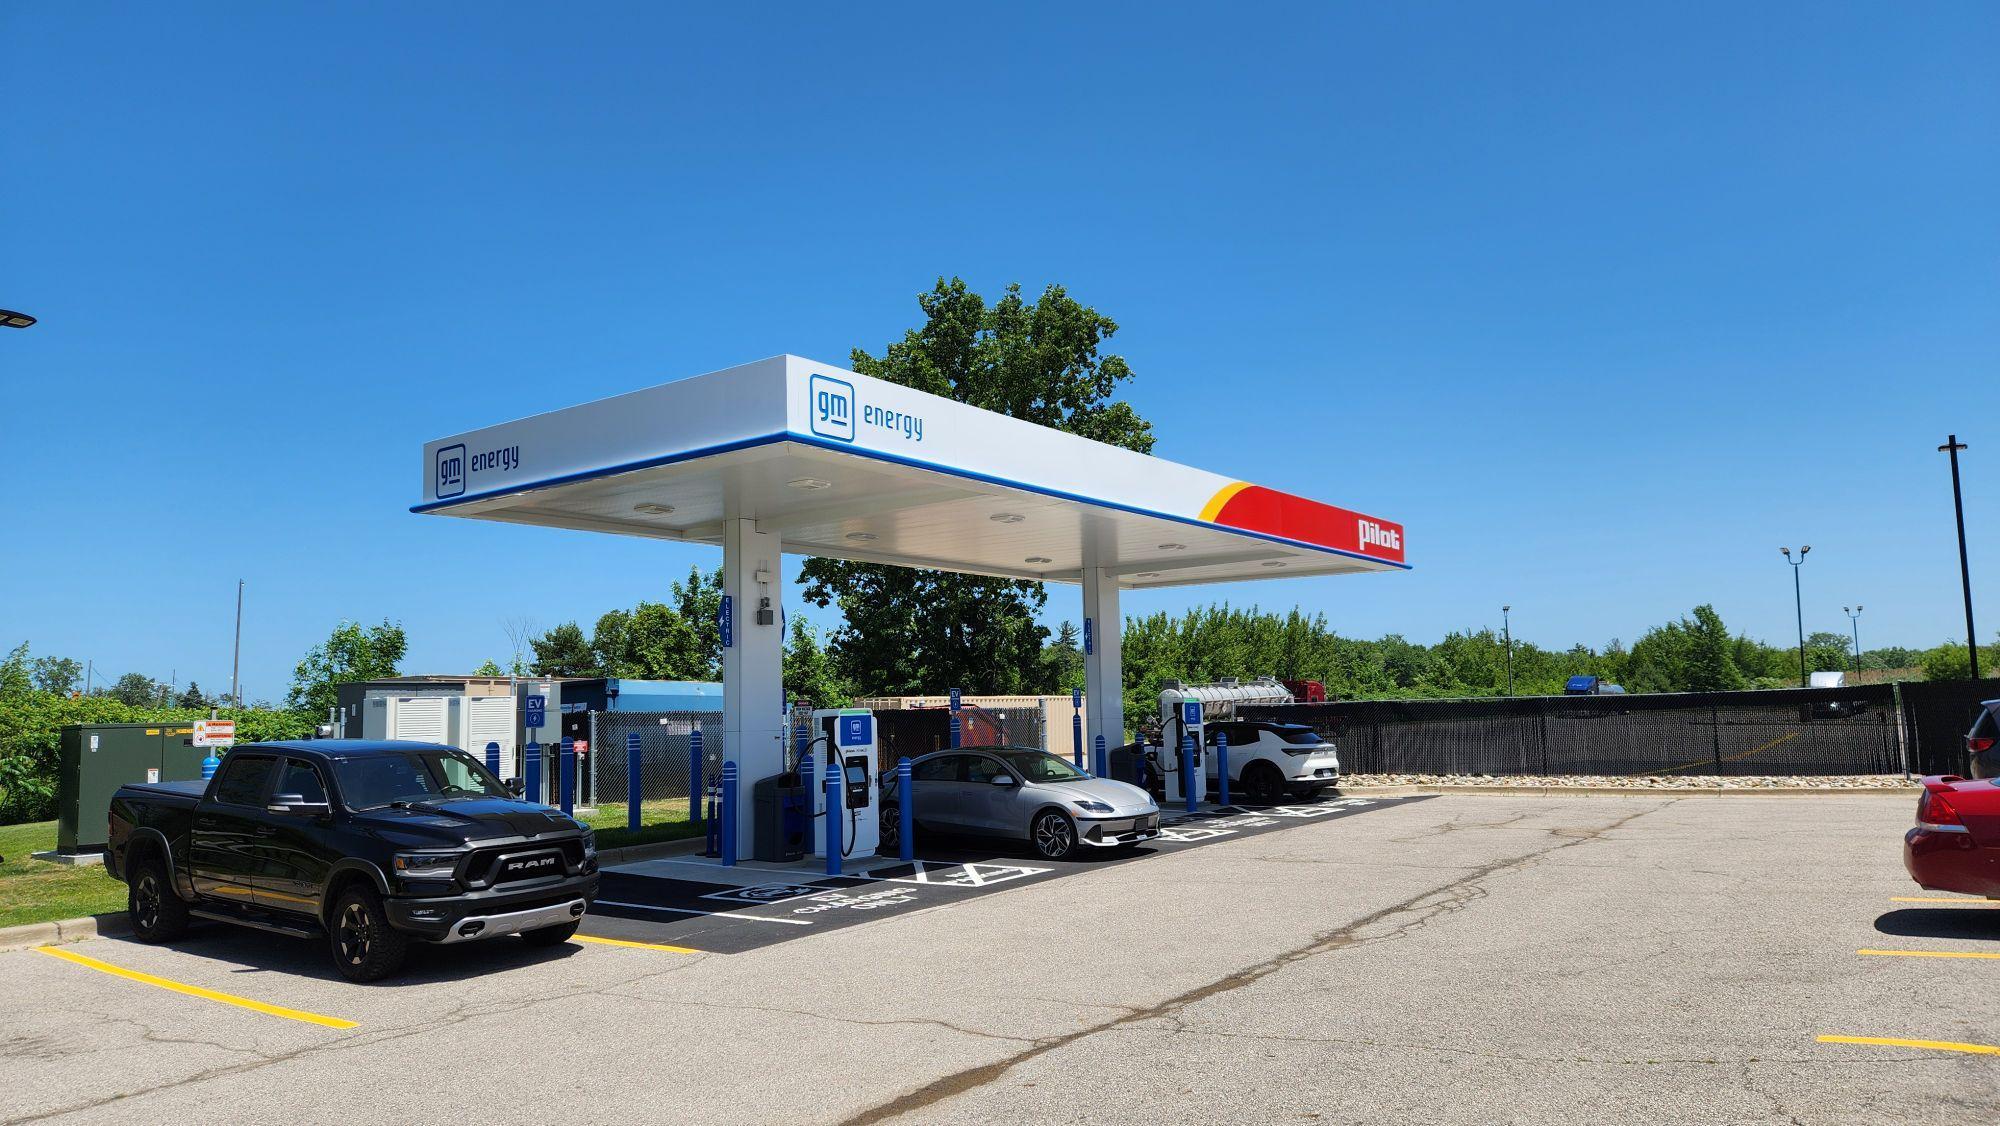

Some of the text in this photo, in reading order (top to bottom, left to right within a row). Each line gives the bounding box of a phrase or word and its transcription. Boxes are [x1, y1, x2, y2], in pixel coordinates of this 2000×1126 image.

[818, 391, 923, 442] gm energy
[441, 445, 519, 486] gm energy
[528, 699, 542, 708] EV
[508, 857, 555, 870] RAM
